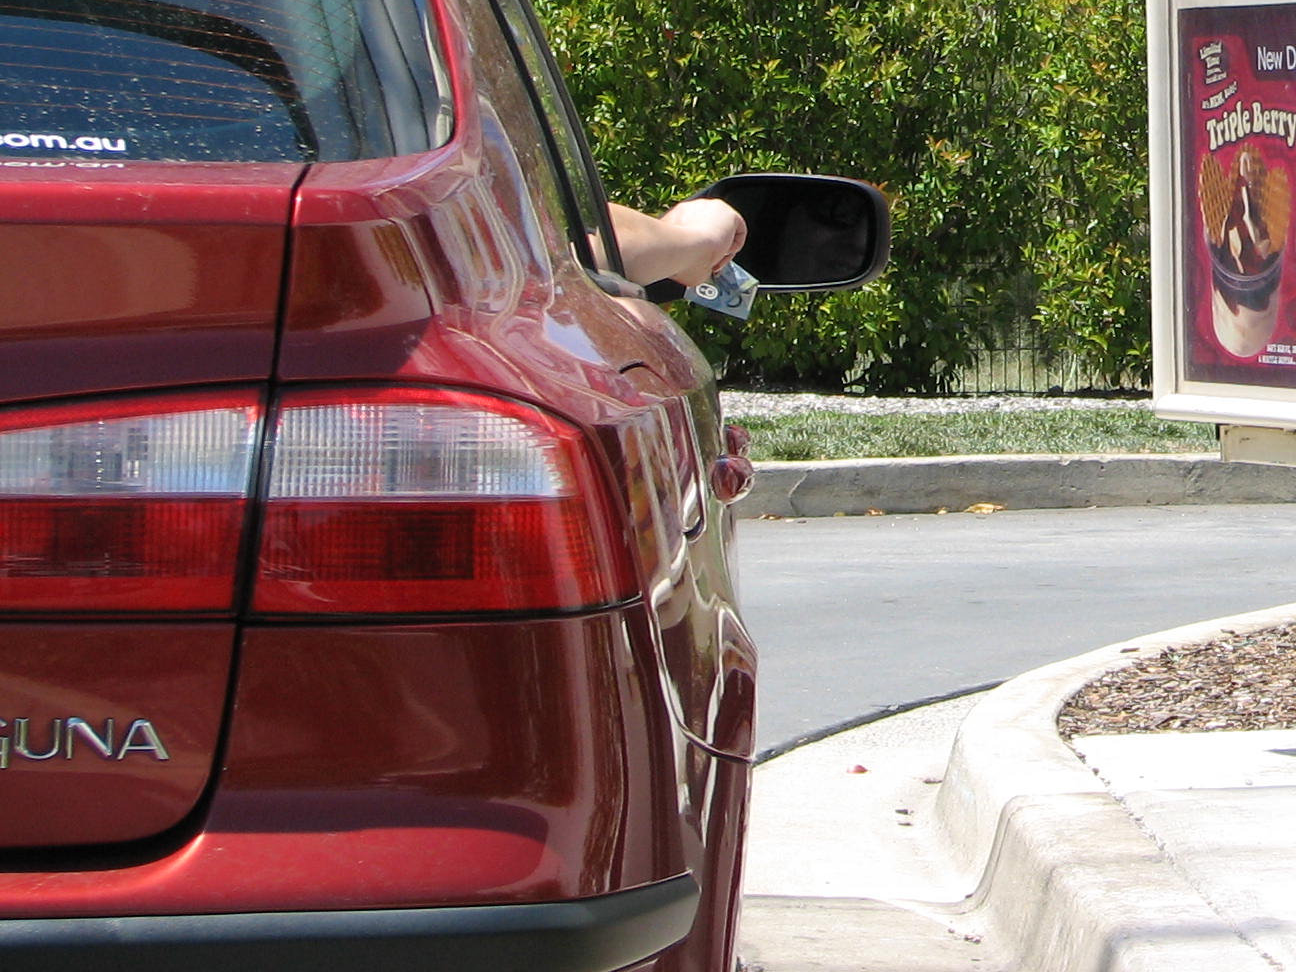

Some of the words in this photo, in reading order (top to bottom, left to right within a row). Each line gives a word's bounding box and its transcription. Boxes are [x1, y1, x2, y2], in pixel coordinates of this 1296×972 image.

[1257, 46, 1283, 70] New
[1207, 101, 1251, 150] Triple
[0, 133, 126, 151] om.au
